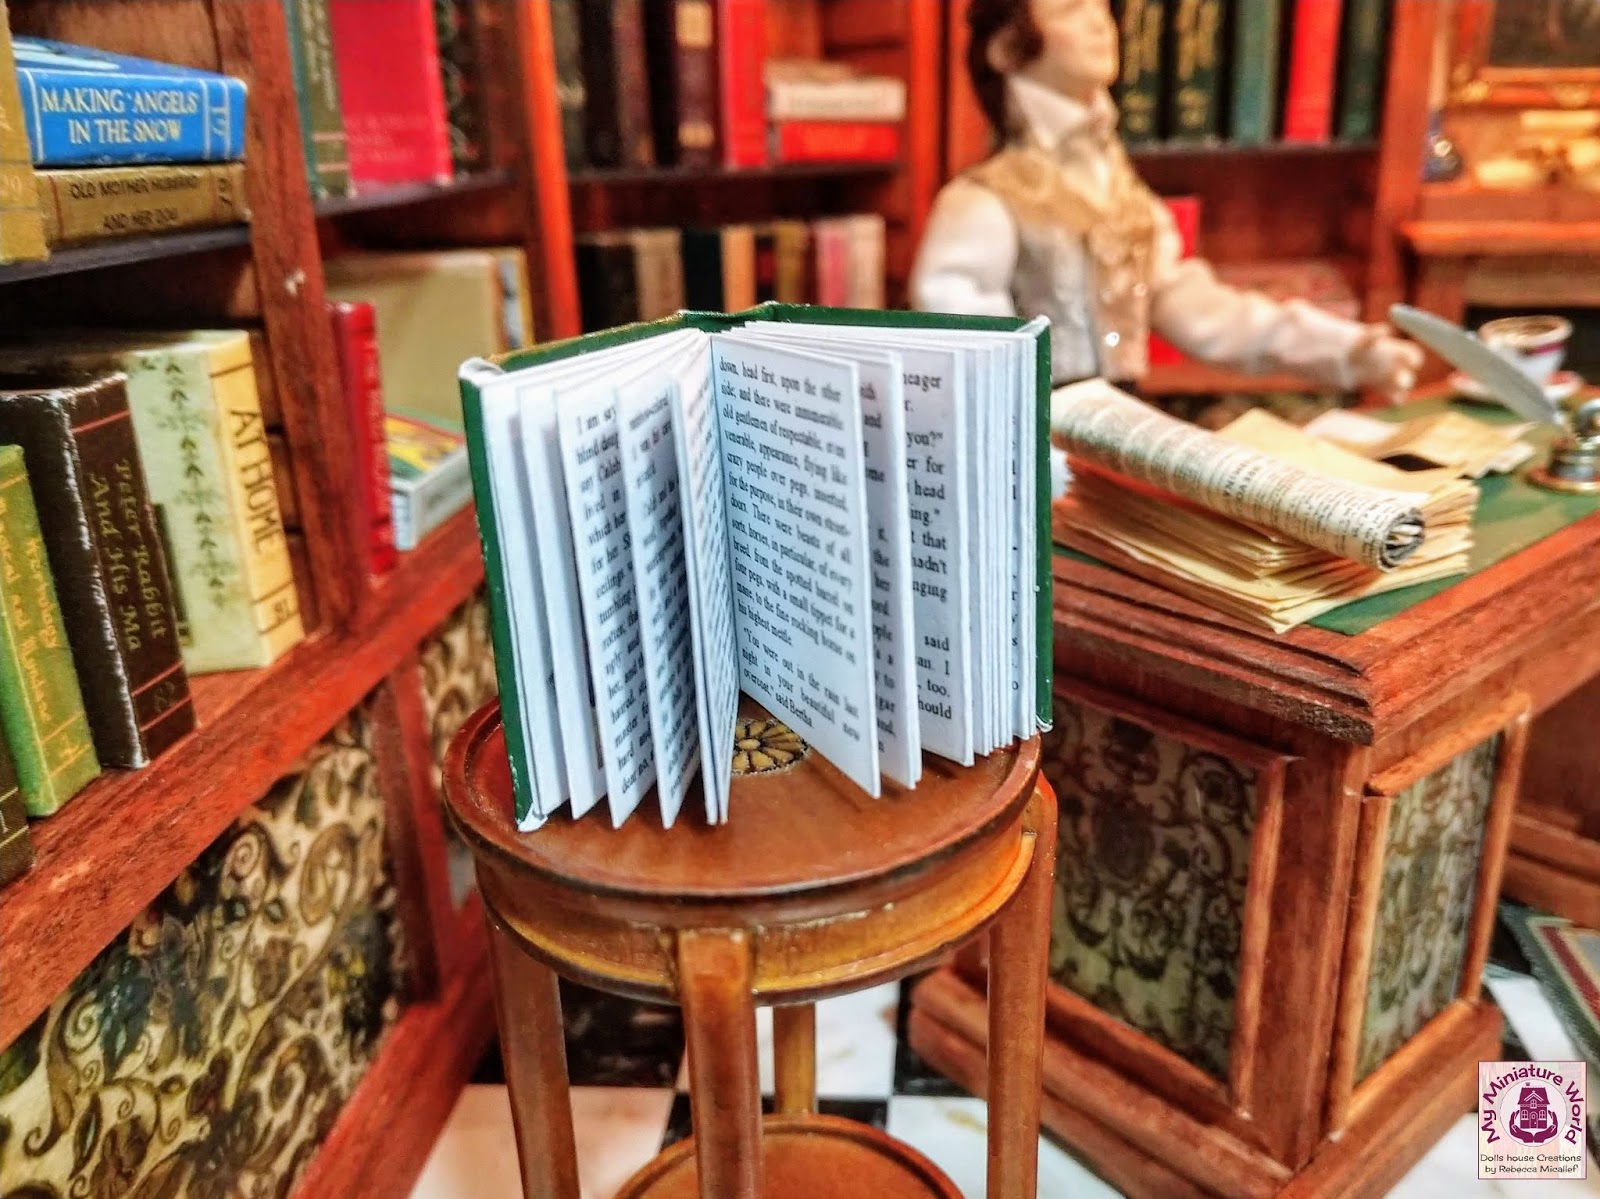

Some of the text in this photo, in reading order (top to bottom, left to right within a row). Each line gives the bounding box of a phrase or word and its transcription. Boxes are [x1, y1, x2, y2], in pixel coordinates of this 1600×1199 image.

[41, 86, 125, 113] MAKING
[68, 118, 91, 144] IN
[94, 118, 131, 143] THE
[133, 118, 181, 144] SNOW
[742, 361, 758, 380] head
[739, 387, 751, 402] and
[753, 389, 770, 408] there
[774, 399, 791, 414] were
[723, 404, 734, 420] old
[736, 411, 768, 432] gentlemen
[770, 419, 778, 435] of
[724, 429, 756, 452] venerable,
[727, 452, 743, 471] crazy
[746, 462, 767, 479] people
[771, 471, 786, 486] over
[926, 456, 945, 475] for
[728, 471, 738, 487] for
[739, 476, 748, 492] the
[750, 485, 776, 508] purpose,
[914, 480, 945, 499] head
[241, 458, 283, 554] HOME
[752, 502, 771, 525] There
[774, 518, 792, 536] were
[113, 458, 167, 639] Peter Rabbit
[772, 537, 779, 552] in
[922, 531, 947, 550] that
[89, 472, 142, 650] And His Ma
[754, 547, 769, 569] from
[772, 559, 782, 575] the
[786, 569, 812, 592] spotted
[734, 556, 747, 575] four
[766, 579, 781, 596] with
[783, 590, 788, 600] a
[738, 598, 748, 615] his
[748, 605, 771, 631] highest
[755, 592, 763, 606] to
[764, 596, 775, 613] the
[776, 603, 790, 622] fine
[763, 643, 779, 662] were
[782, 658, 794, 673] out
[924, 635, 950, 652] said
[742, 648, 759, 667] night
[764, 660, 771, 677] in
[777, 673, 794, 693] your
[775, 692, 789, 709] said
